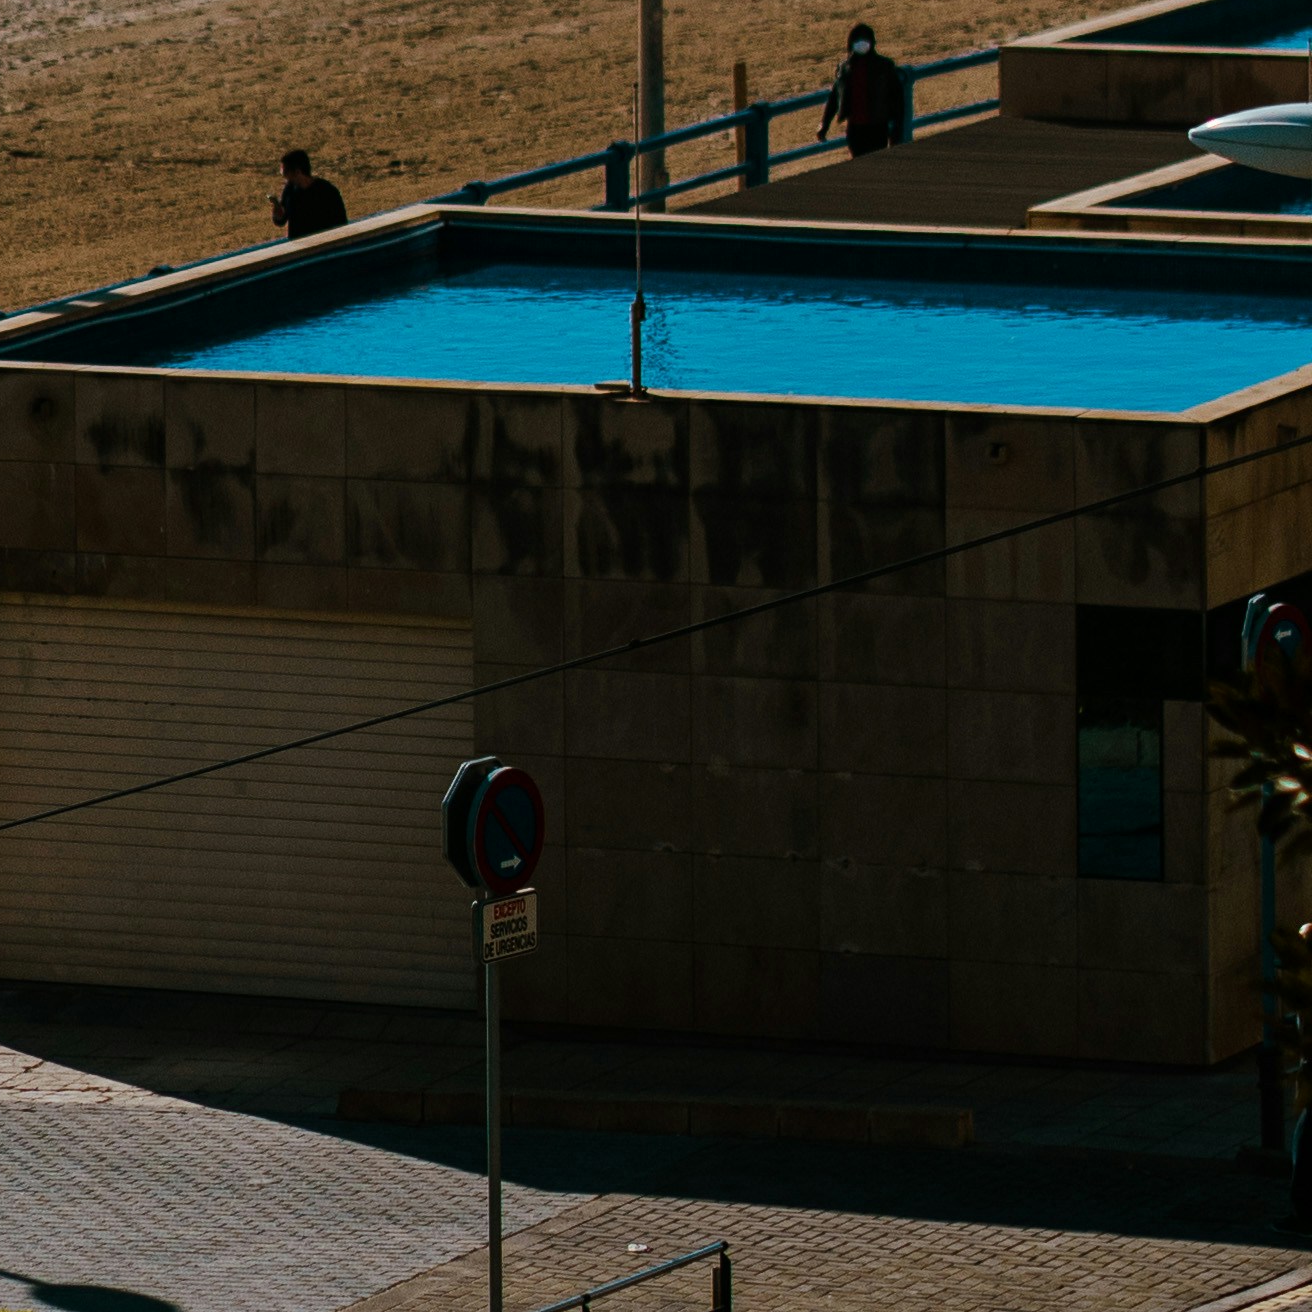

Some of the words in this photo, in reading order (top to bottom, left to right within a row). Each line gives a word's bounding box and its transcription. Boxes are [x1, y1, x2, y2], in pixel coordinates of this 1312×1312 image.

[493, 898, 526, 920] EXCEPTO
[490, 916, 528, 939] SERVICIOS
[484, 942, 494, 958] DE
[495, 931, 536, 956] URGENCIAS
